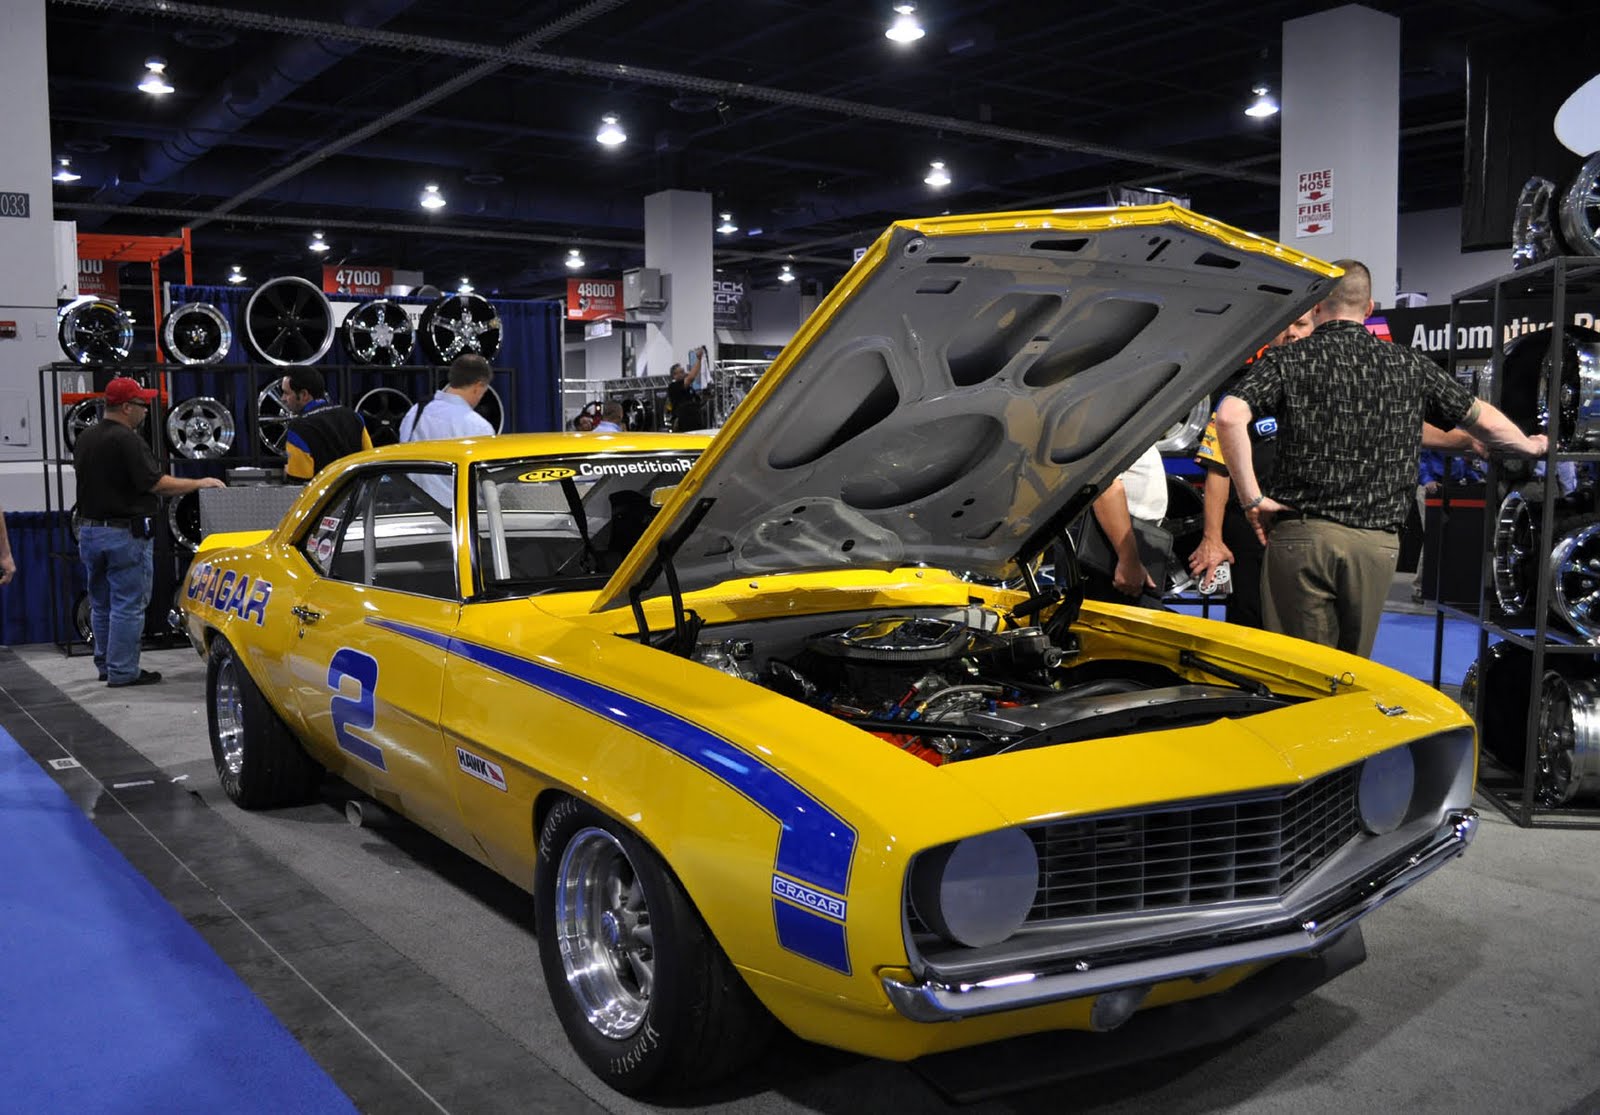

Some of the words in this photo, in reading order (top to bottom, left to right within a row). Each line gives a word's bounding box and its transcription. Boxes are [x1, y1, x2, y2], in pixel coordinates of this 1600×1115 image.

[1299, 170, 1331, 183] FIRE
[1299, 180, 1331, 192] HOSE
[1, 194, 25, 216] 033
[1299, 203, 1331, 215] FIRE
[336, 269, 380, 286] 47000
[578, 283, 615, 297] 48000
[580, 458, 698, 477] CompetitionR
[187, 563, 273, 627] CRAGAR
[327, 646, 388, 773] 2
[457, 748, 489, 777] HAWK
[775, 881, 841, 914] CRAGAR
